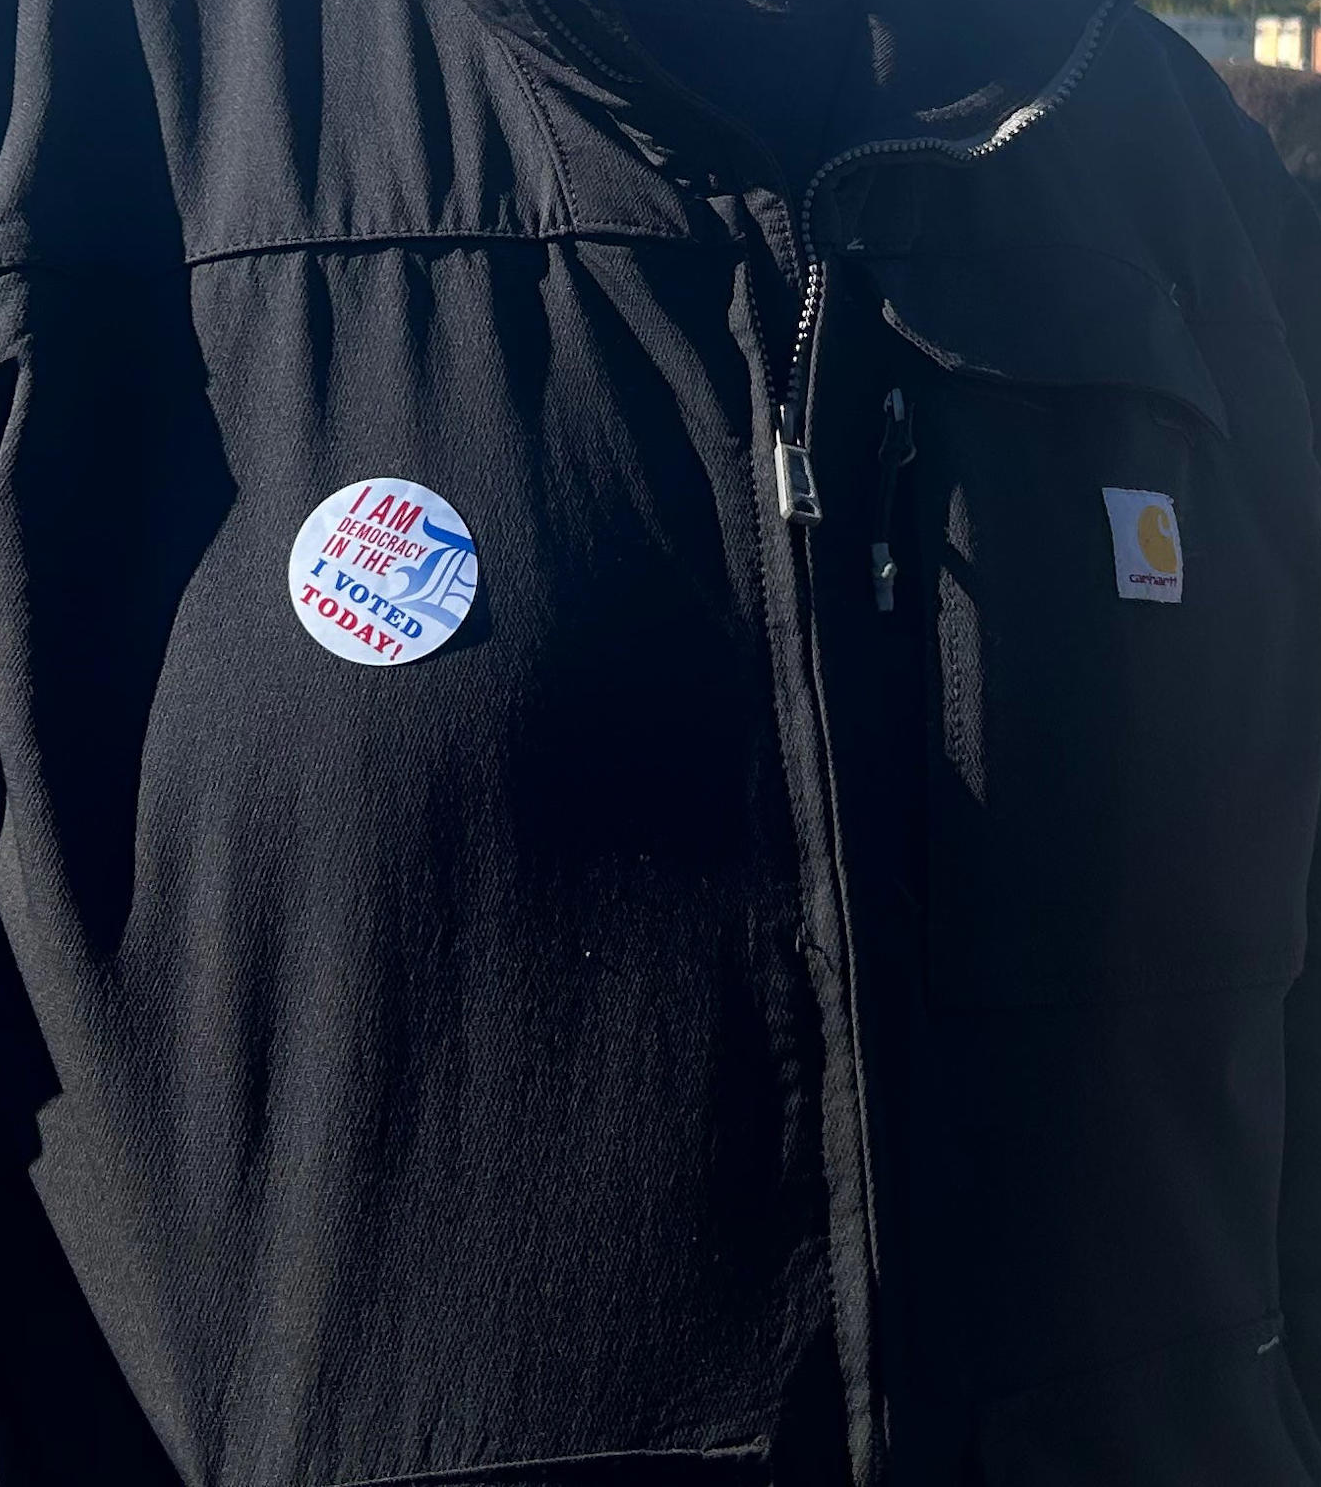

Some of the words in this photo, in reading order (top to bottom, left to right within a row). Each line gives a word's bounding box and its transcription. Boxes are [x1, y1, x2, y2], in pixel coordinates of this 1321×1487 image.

[348, 486, 373, 514] I
[366, 494, 424, 535] AM
[321, 534, 352, 559] IN
[352, 544, 398, 577] THE
[336, 517, 428, 562] DEMOCRACY
[299, 584, 404, 661] TODAY!
[310, 558, 329, 578] I
[332, 570, 423, 639] VOTED
